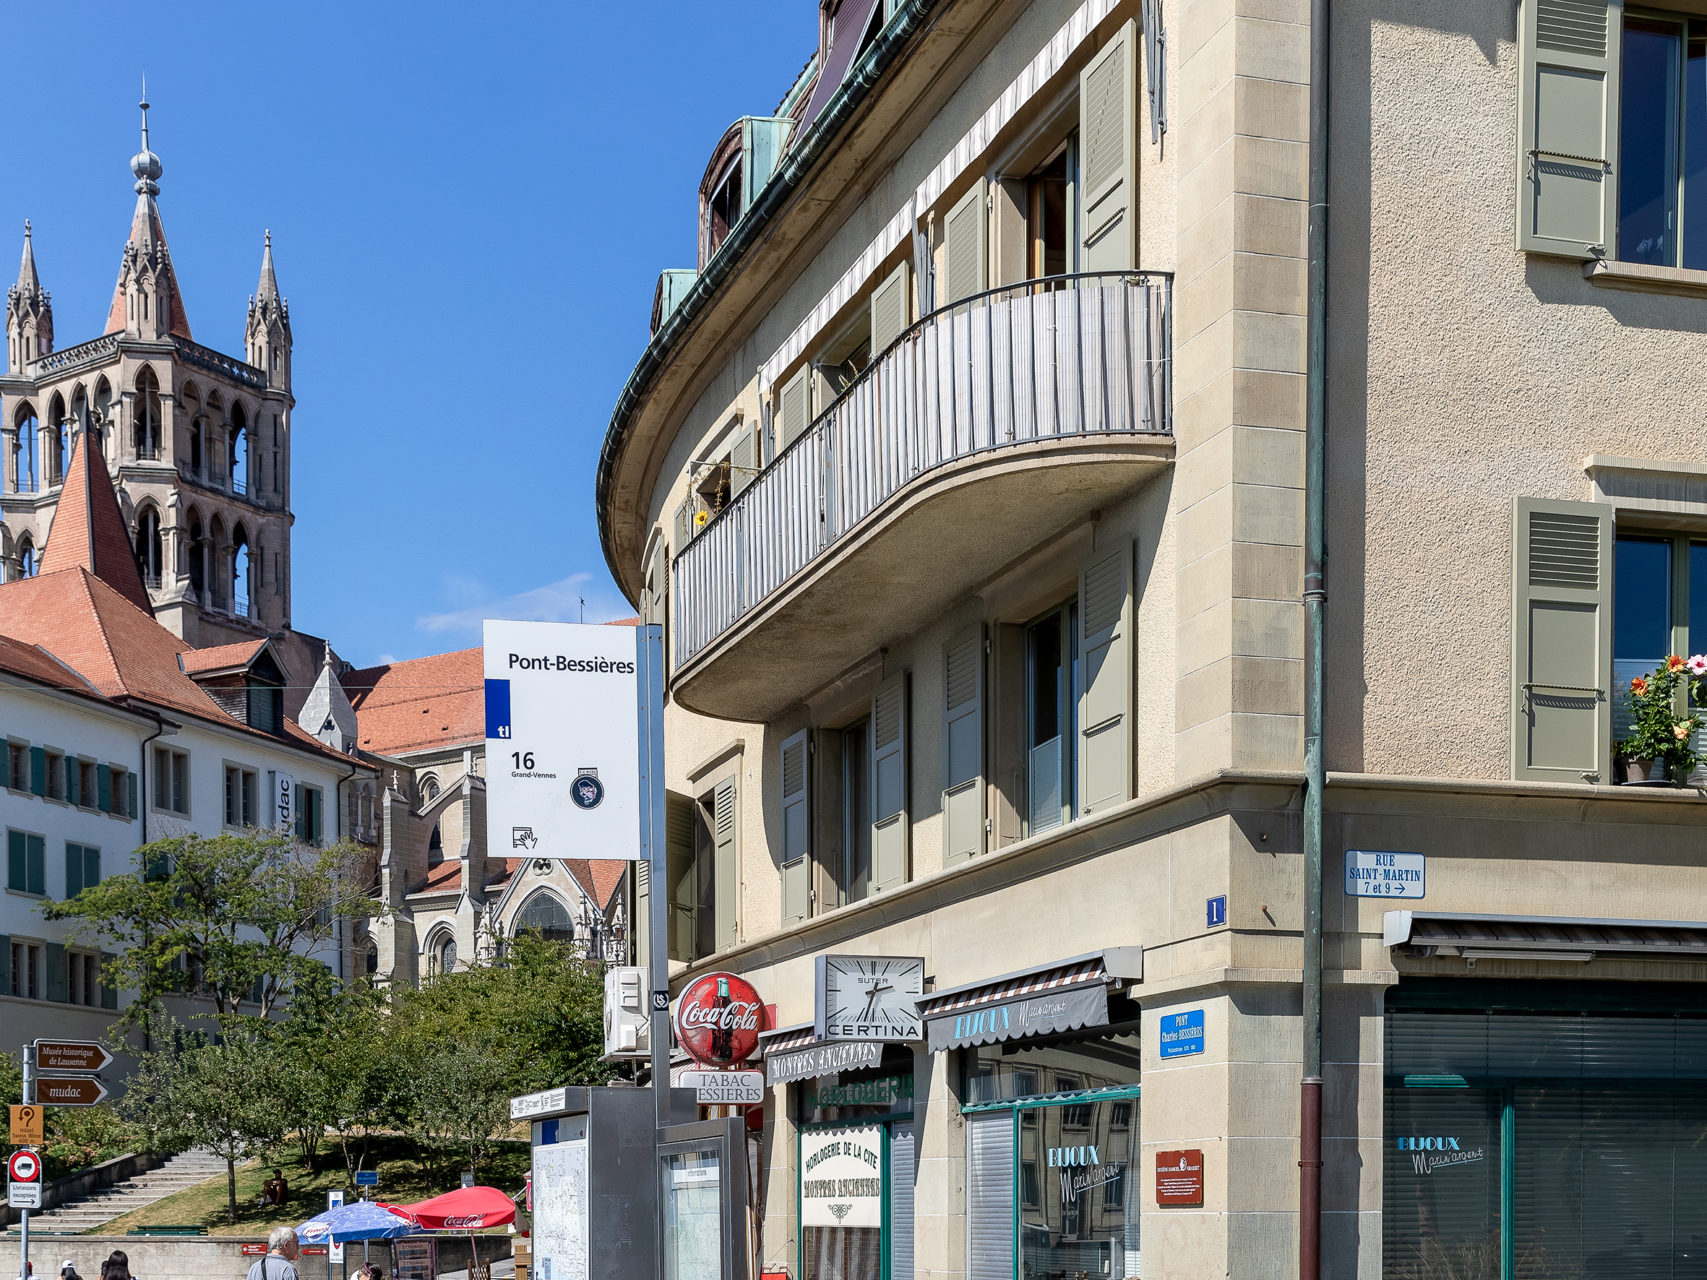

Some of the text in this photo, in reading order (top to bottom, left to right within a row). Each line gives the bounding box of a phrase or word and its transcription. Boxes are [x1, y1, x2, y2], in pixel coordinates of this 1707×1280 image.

[508, 653, 635, 674] Pont-Bessières
[497, 725, 510, 738] tl
[511, 751, 535, 770] 16
[511, 771, 557, 779] Grand-Vennes
[277, 778, 290, 841] udac
[1375, 854, 1396, 867] RUE
[1349, 867, 1421, 882] SAINT-MARTIN
[1364, 881, 1391, 894] 7 et 9
[1212, 901, 1218, 922] 1
[681, 1001, 761, 1030] Coca-Cola
[953, 1006, 1012, 1040] BIJOUX
[1175, 1014, 1189, 1027] PONT
[827, 1024, 919, 1037] CERTINA
[42, 1046, 94, 1058] Musée historique
[49, 1057, 87, 1066] de Lausanne
[772, 1042, 877, 1079] MONTRES ANCIENNES
[698, 1074, 751, 1087] TABAC
[49, 1084, 81, 1098] mudac
[699, 1088, 761, 1101] ESSIERES
[1397, 1136, 1460, 1151] BIJOUX
[805, 1141, 878, 1174] HORLOGERIE DE LA CITE
[1048, 1144, 1100, 1168] BIJOUX
[803, 1178, 880, 1198] MONTRES ANCIENNES
[443, 1213, 487, 1228] Coca-Cola
